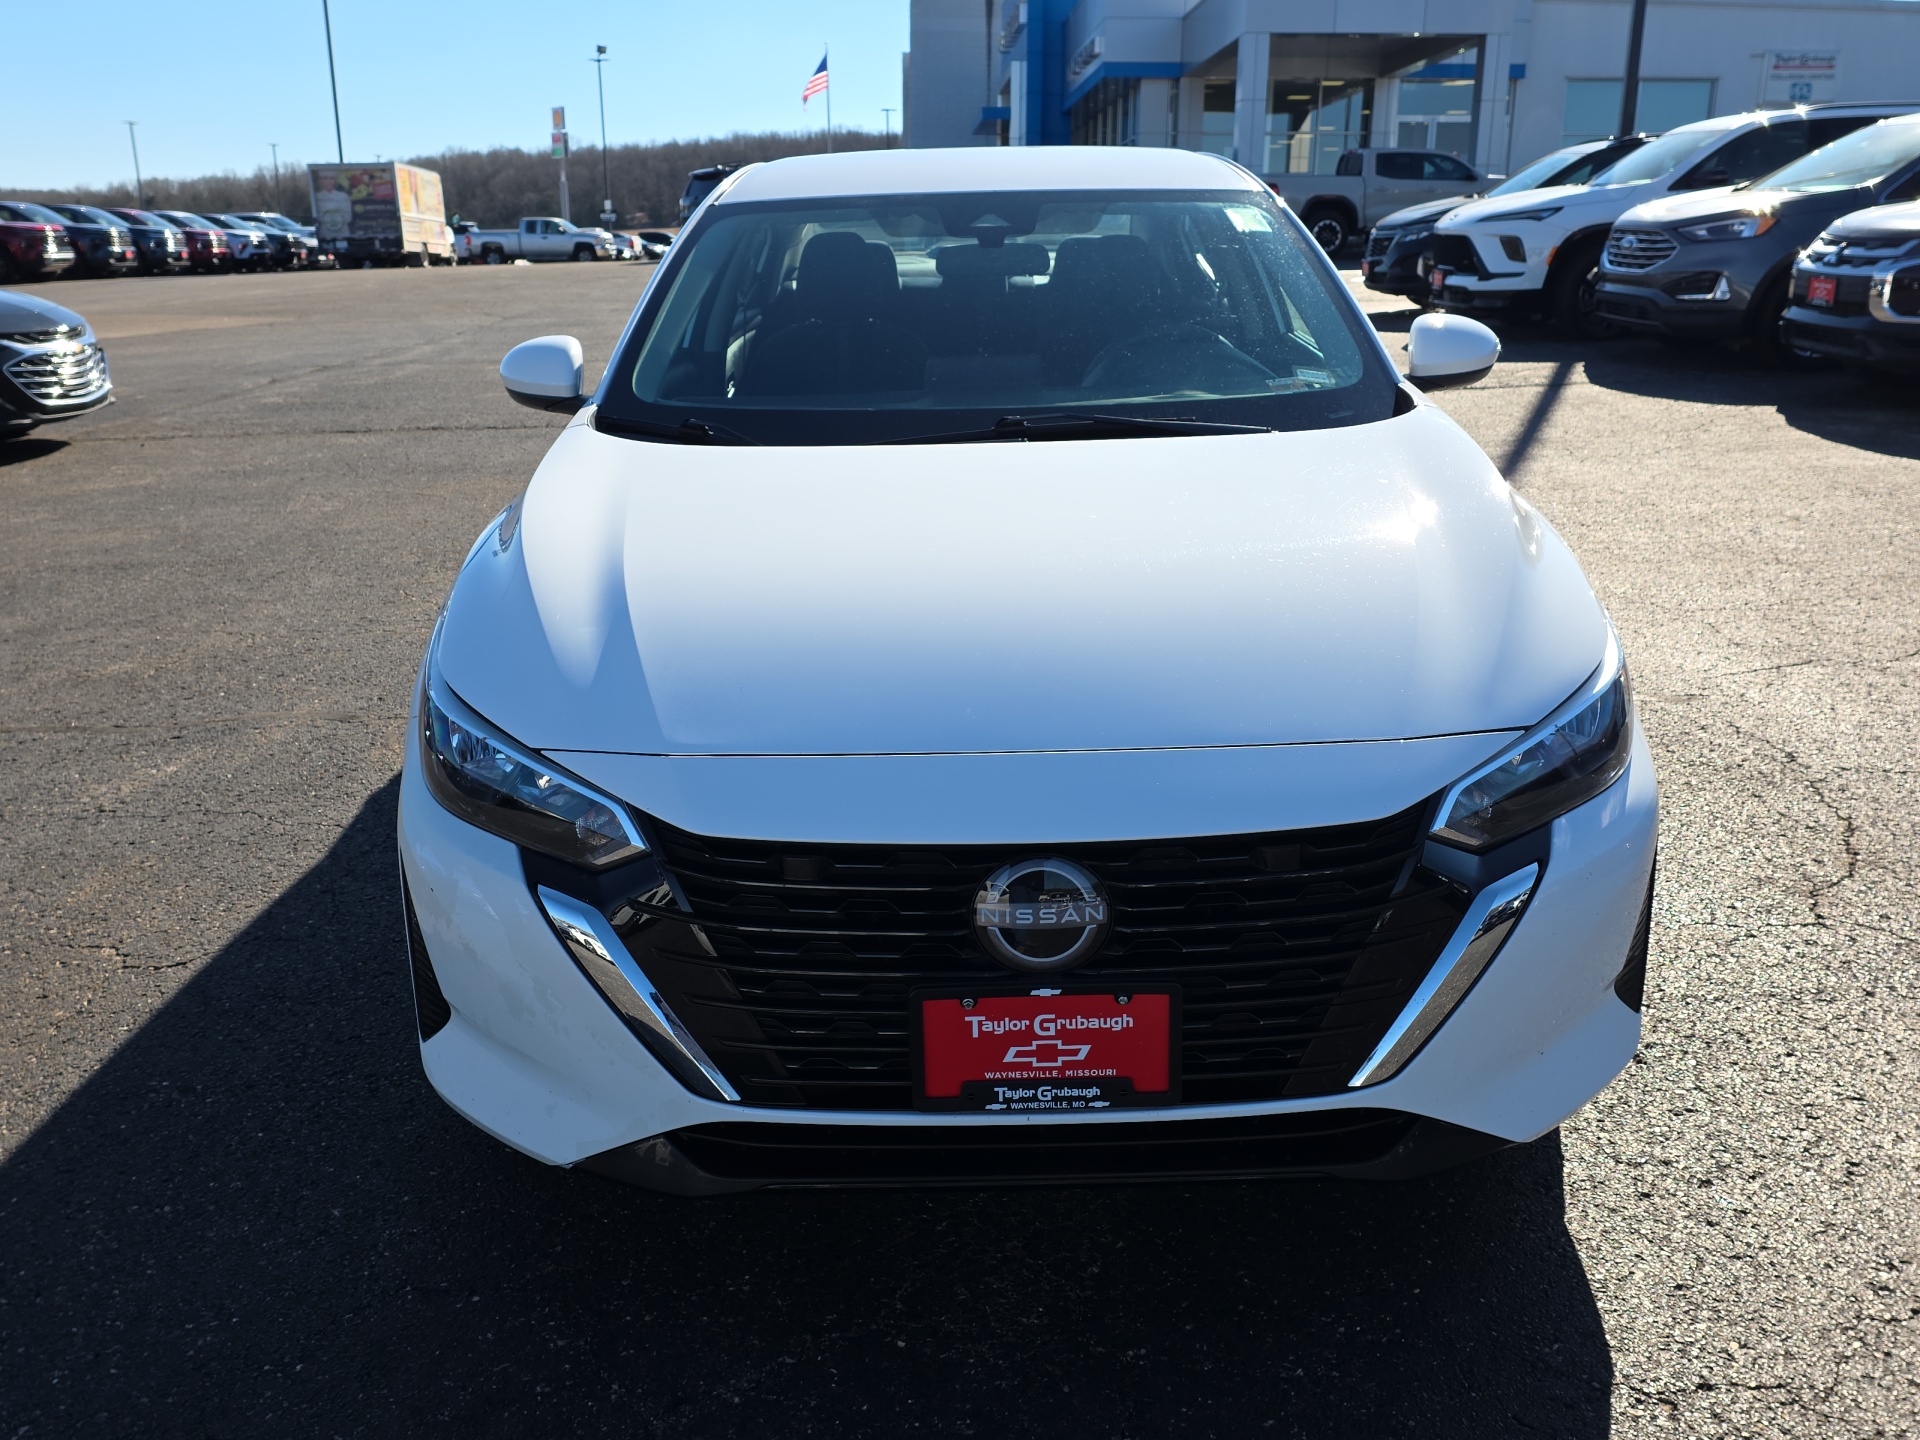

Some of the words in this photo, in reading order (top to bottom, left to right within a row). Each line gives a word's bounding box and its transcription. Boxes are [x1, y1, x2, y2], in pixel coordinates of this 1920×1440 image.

[980, 905, 1104, 924] NISSAN
[965, 1014, 1030, 1038] Taylor
[1033, 1013, 1134, 1036] Grubaugh
[984, 1070, 1062, 1079] WAYNESVILLE,
[1065, 1068, 1117, 1077] MISSOURI
[993, 1086, 1036, 1102] Taylor
[1037, 1085, 1101, 1101] Grubaugh
[1010, 1101, 1070, 1109] WAYNESVILLE,
